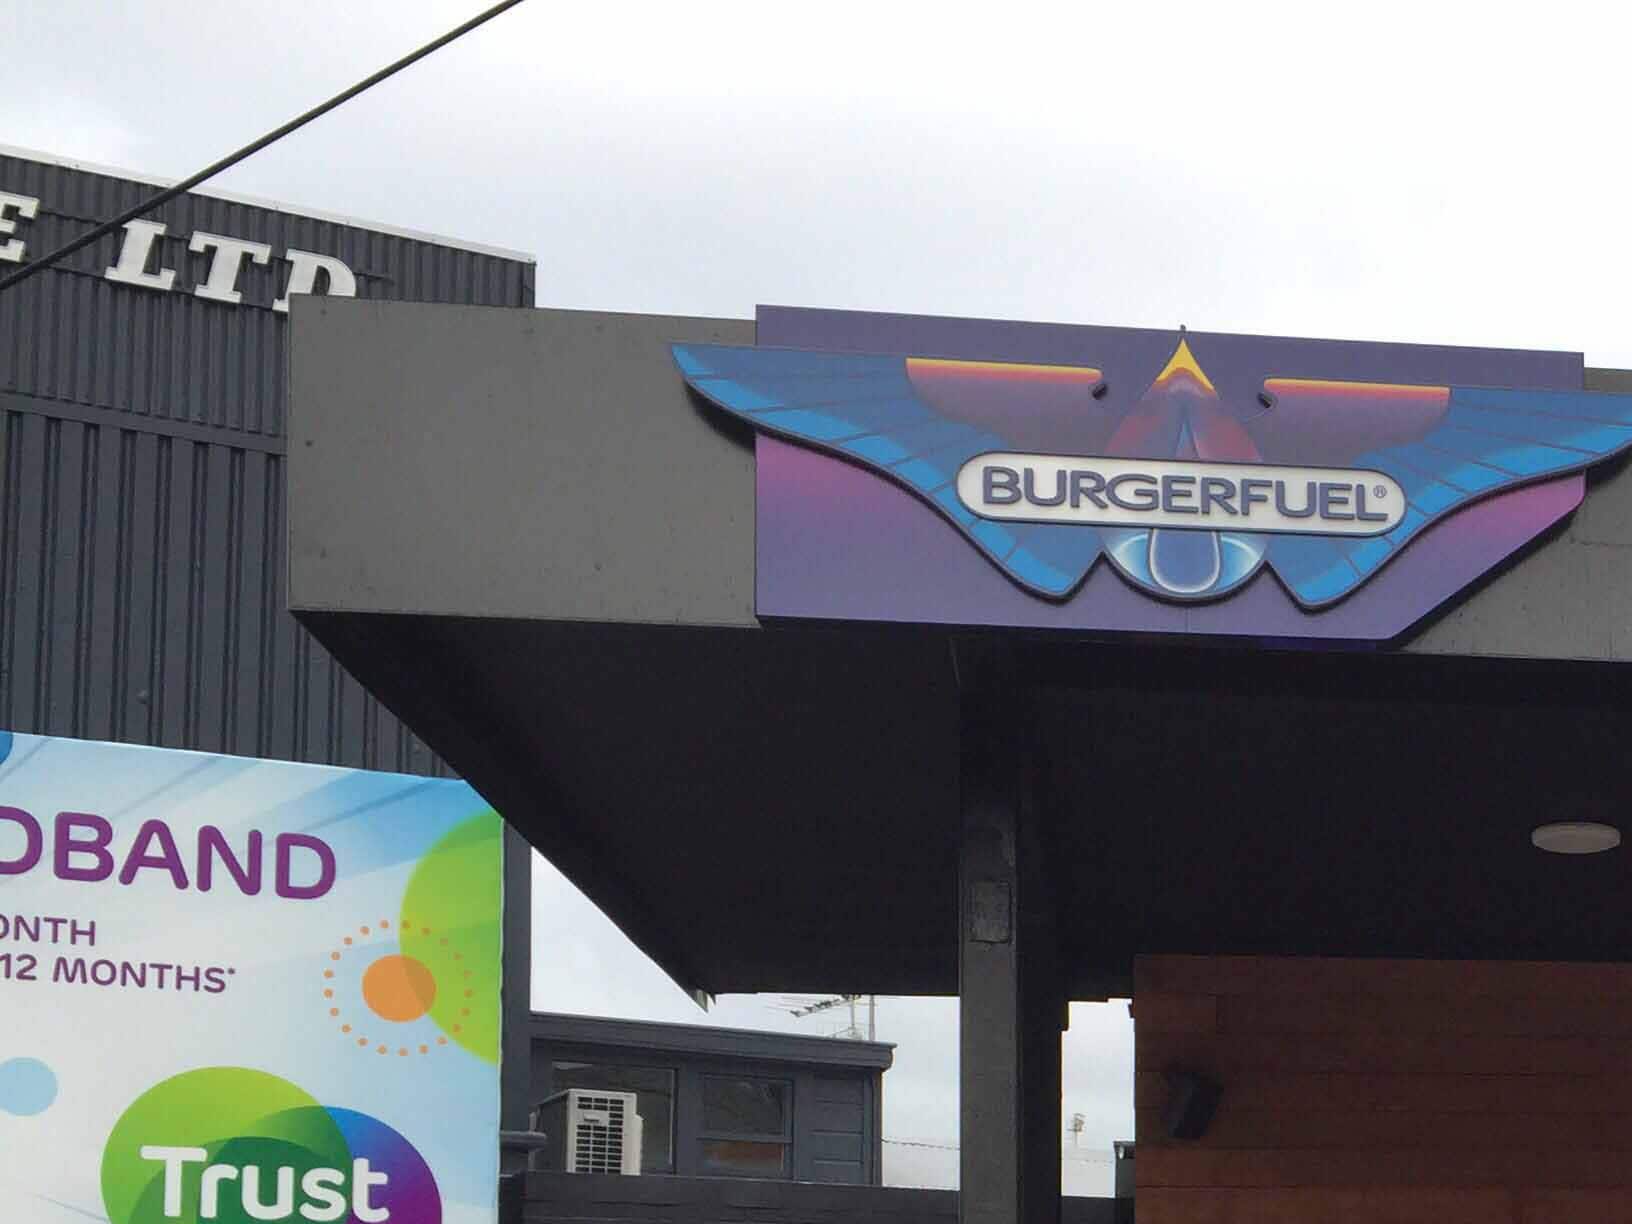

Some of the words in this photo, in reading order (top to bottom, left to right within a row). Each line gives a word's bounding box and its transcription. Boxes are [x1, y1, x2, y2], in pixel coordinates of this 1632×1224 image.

[104, 216, 356, 313] LTD
[0, 914, 96, 947] NTH
[140, 1145, 390, 1223] Trust
